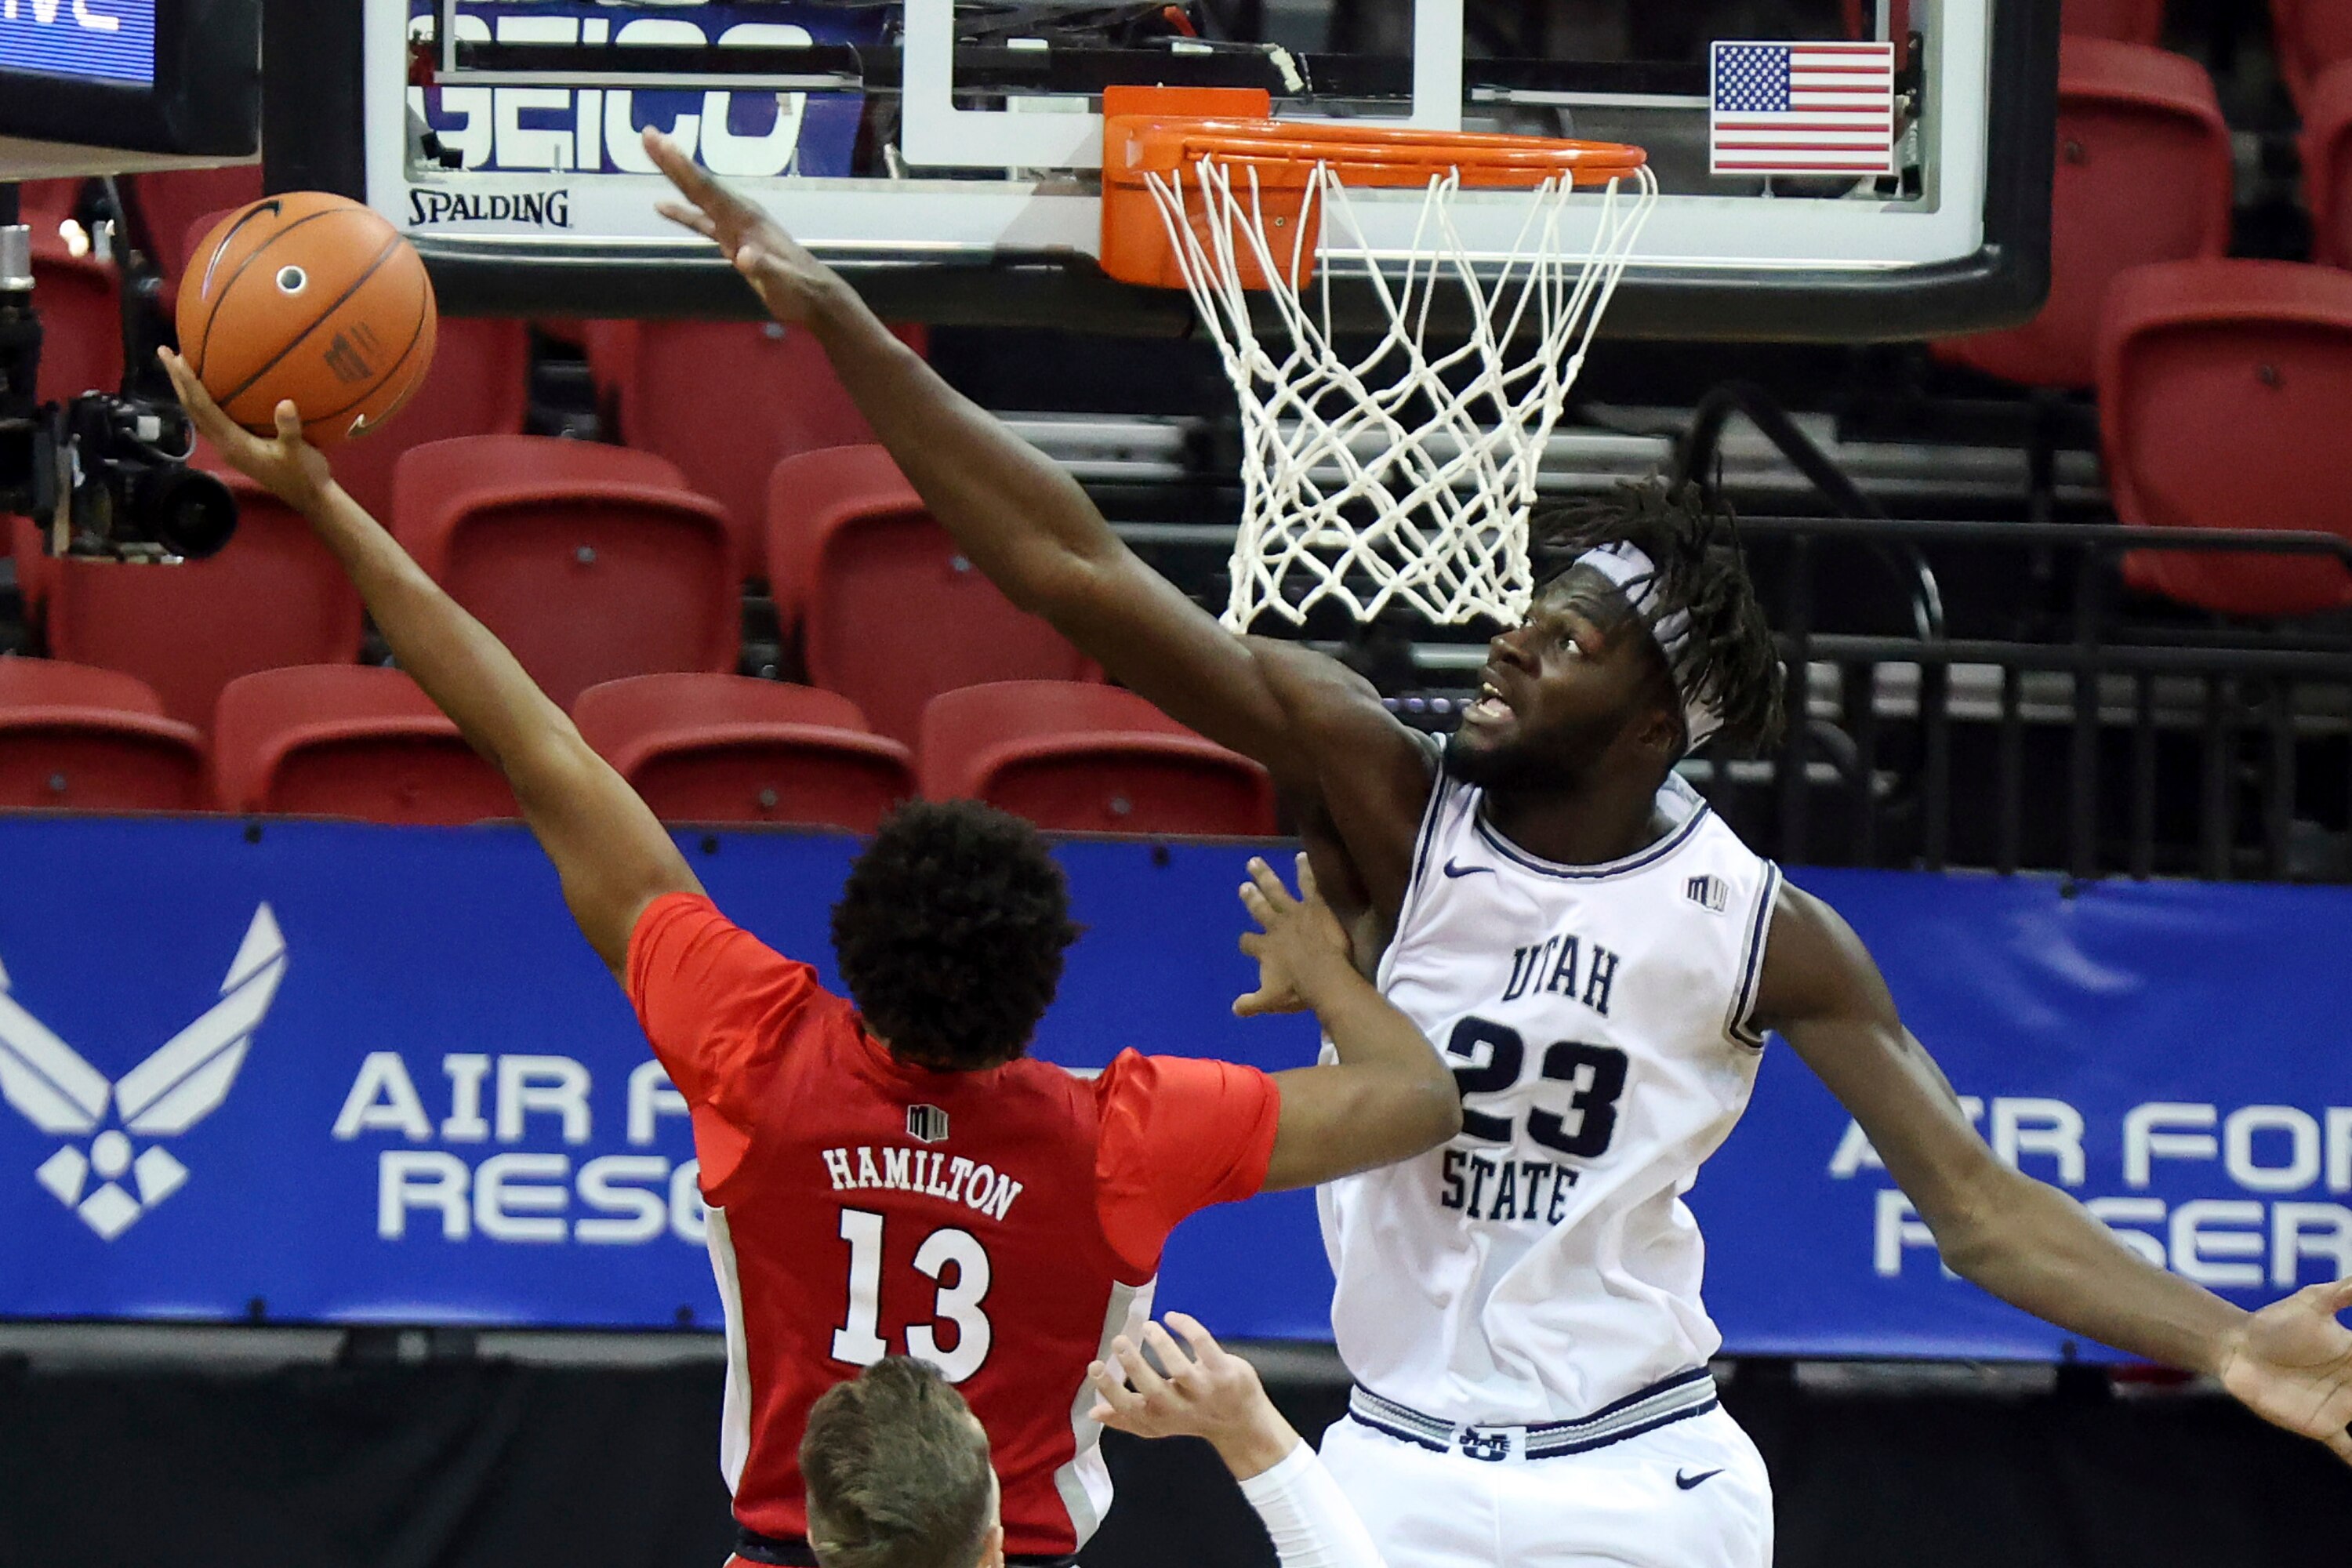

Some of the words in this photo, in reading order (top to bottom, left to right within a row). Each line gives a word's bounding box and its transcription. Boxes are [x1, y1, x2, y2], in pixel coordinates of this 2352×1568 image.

[408, 187, 568, 228] SPALDING
[1501, 933, 1621, 1017] UTAH
[330, 1051, 593, 1144] AIR
[1446, 1016, 1628, 1159] 23
[822, 1146, 1023, 1221] HAMILTON
[1441, 1149, 1580, 1226] STATE
[830, 1207, 994, 1385] 13
